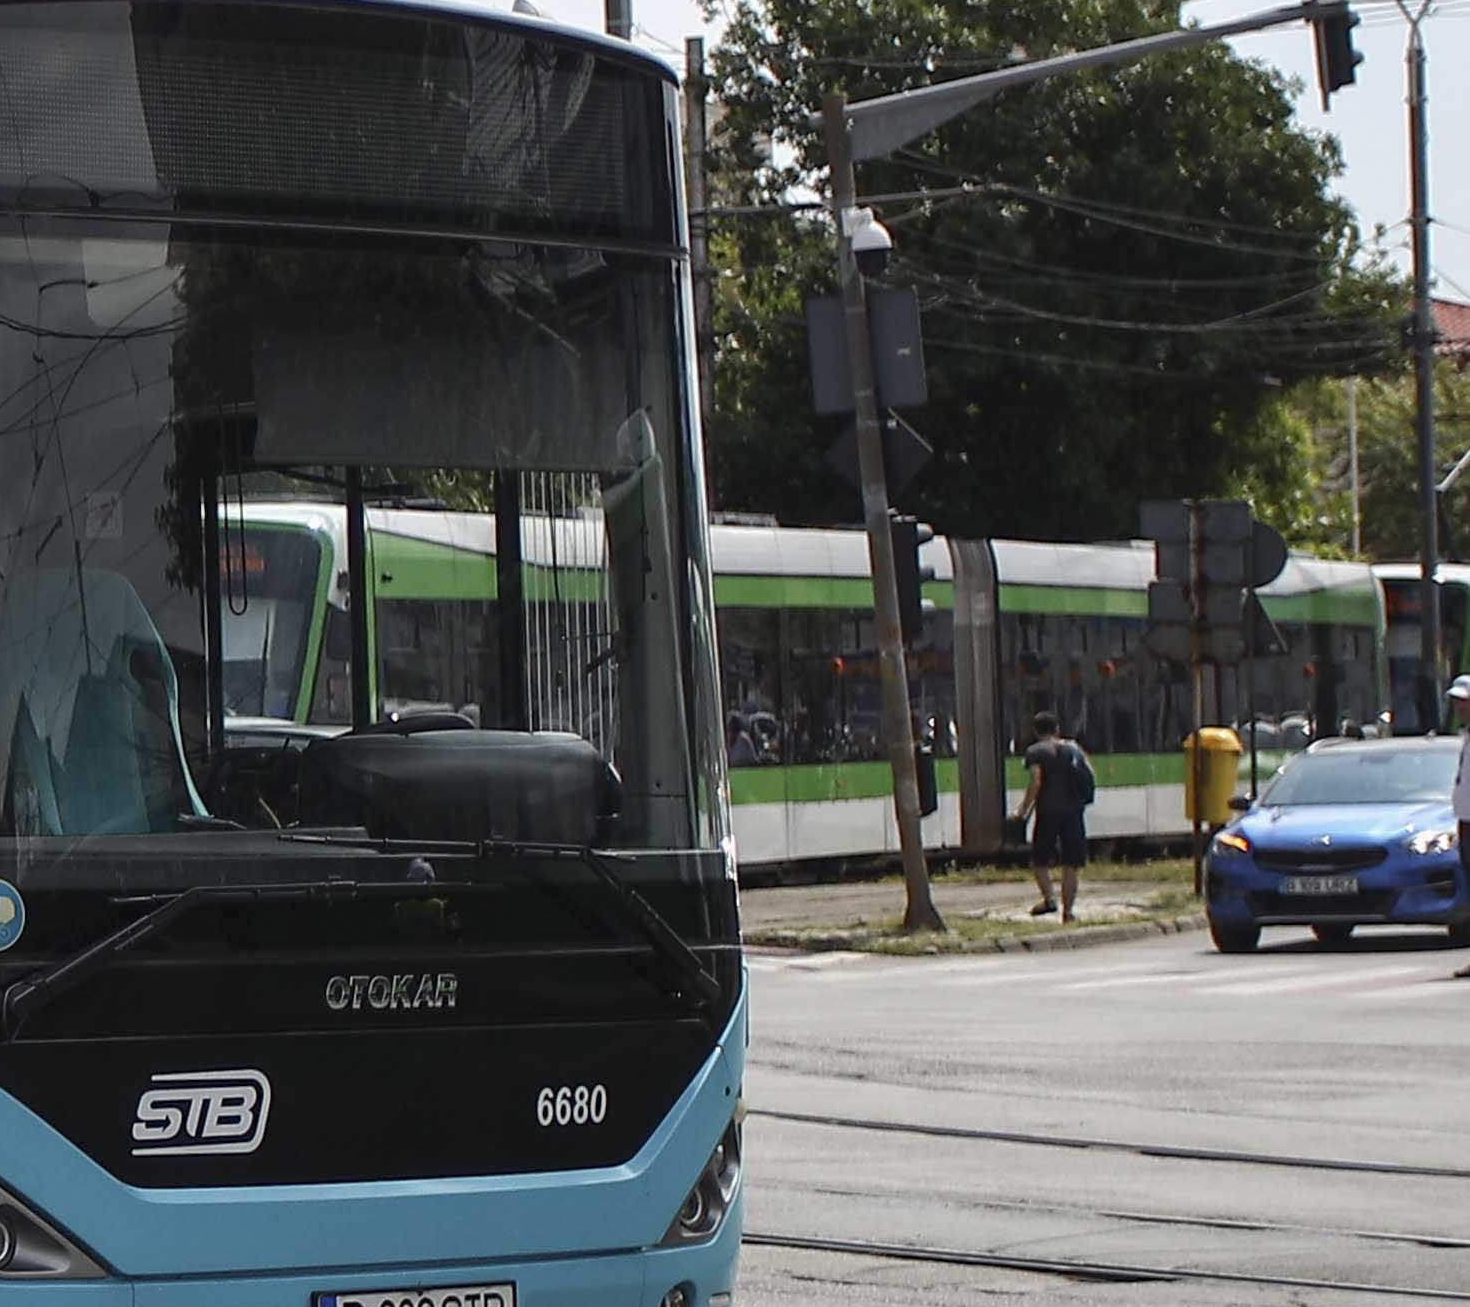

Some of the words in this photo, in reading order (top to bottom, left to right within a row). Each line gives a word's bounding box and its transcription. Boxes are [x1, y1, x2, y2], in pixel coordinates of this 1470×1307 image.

[325, 973, 458, 1010] OTOKAR
[132, 1085, 258, 1141] STB
[536, 1084, 608, 1127] 6680
